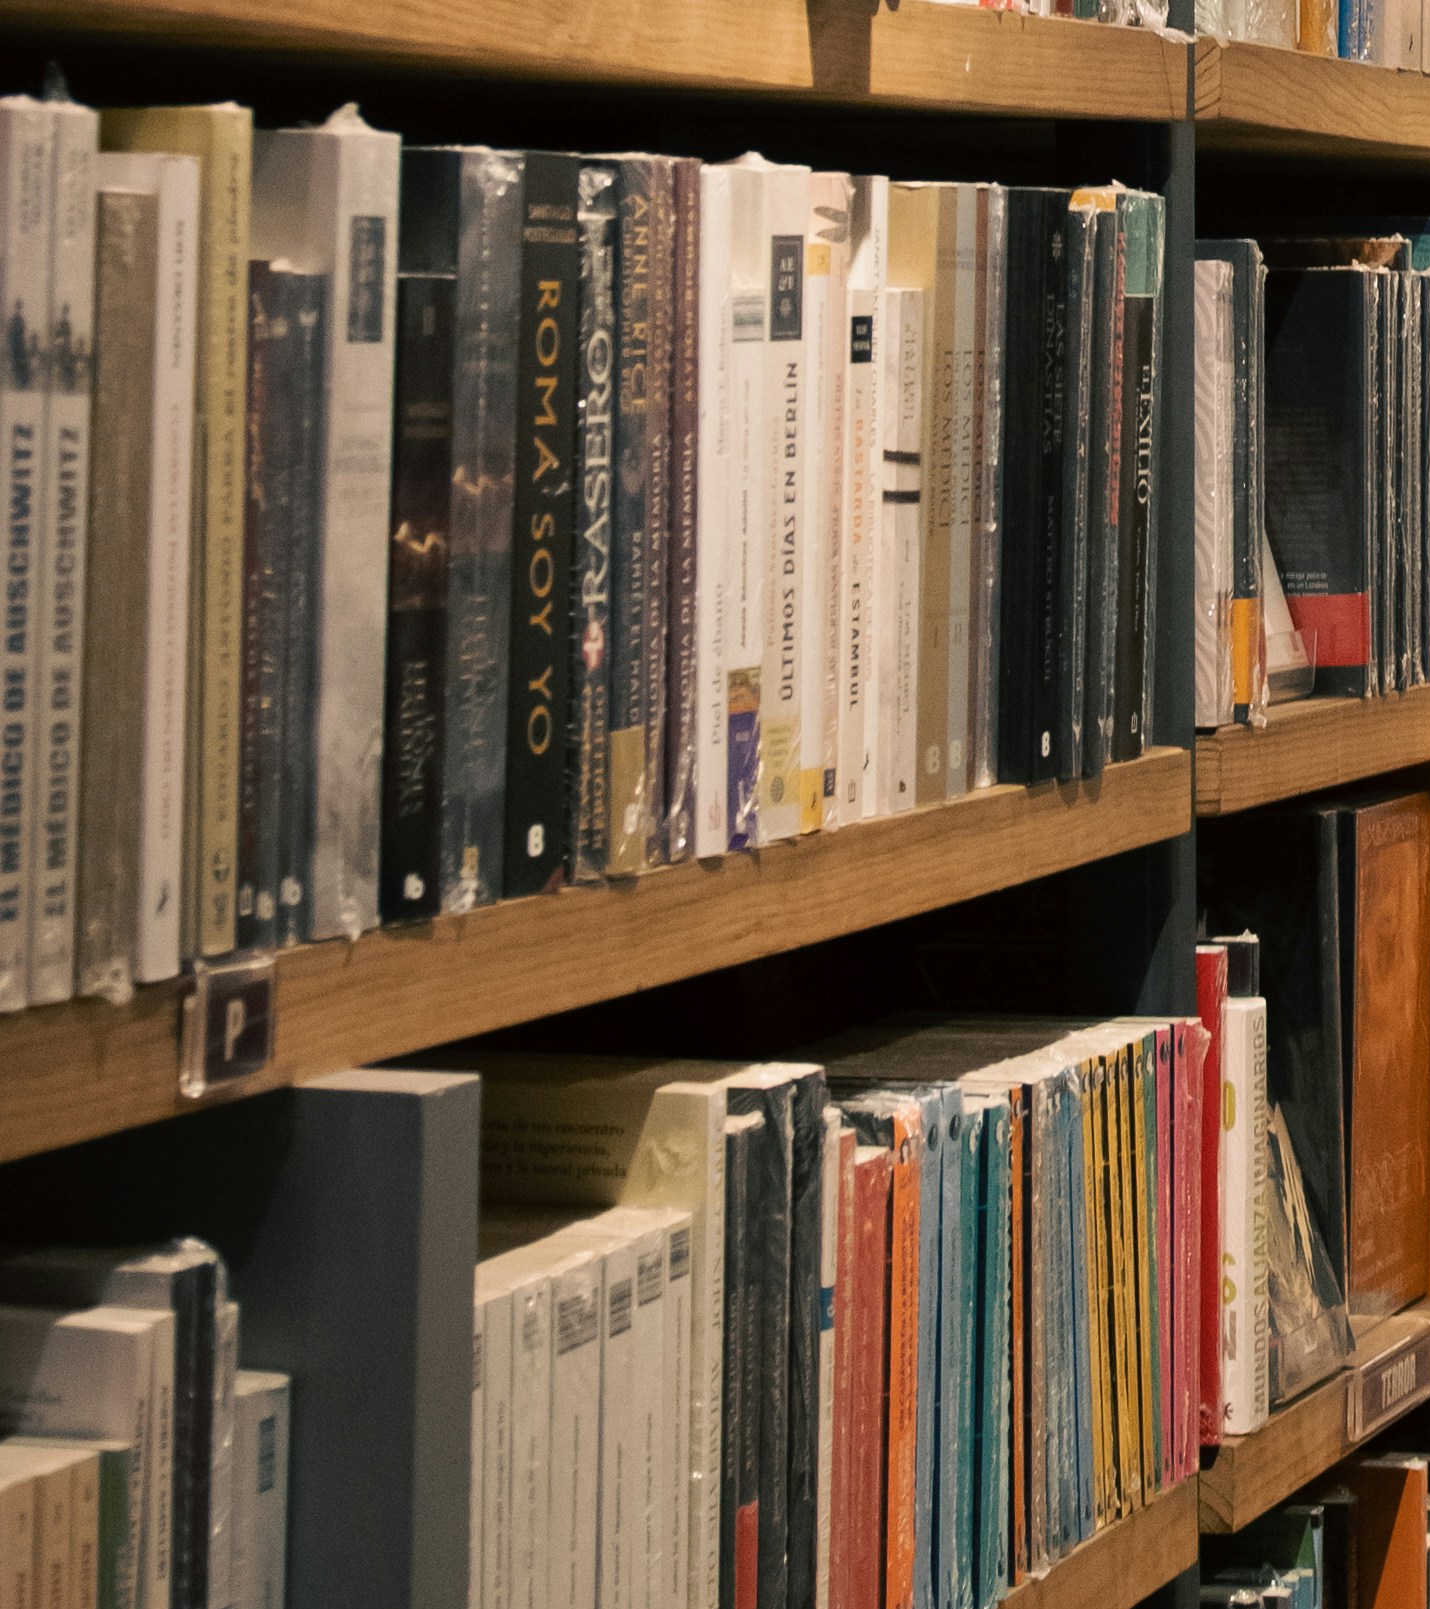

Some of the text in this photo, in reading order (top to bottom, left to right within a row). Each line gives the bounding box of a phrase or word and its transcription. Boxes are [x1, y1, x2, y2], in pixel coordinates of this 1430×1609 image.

[631, 195, 649, 415] ANNE RICE
[1053, 302, 1065, 444] LAS SIETE
[580, 330, 613, 607] RASERO
[852, 418, 864, 545] BASTARDA
[939, 350, 953, 528] LOS MEDICI
[961, 350, 972, 526] LOS MEDICI
[1137, 365, 1151, 505] EL EXILIO
[7, 422, 34, 653] AUSCHWITZ
[528, 280, 561, 756] ROMA SOY YO
[650, 433, 663, 628] DE LA MEMORIA
[780, 361, 798, 702] ÚLTIMOS DÍAS EN BERLÍN
[1043, 495, 1055, 687] MATTEO STRUKUL
[4, 665, 27, 712] DE
[44, 426, 81, 919] EL MÉDICO DE AUSCHWITZ
[709, 582, 725, 746] Piel de ébano
[849, 583, 860, 712] ESTAMBUL
[0, 722, 24, 875] MÉDICO
[224, 998, 245, 1063] P
[1252, 1190, 1268, 1297] ALIANZA
[1253, 1300, 1269, 1415] MUNDOS
[1380, 1352, 1417, 1409] TERROR
